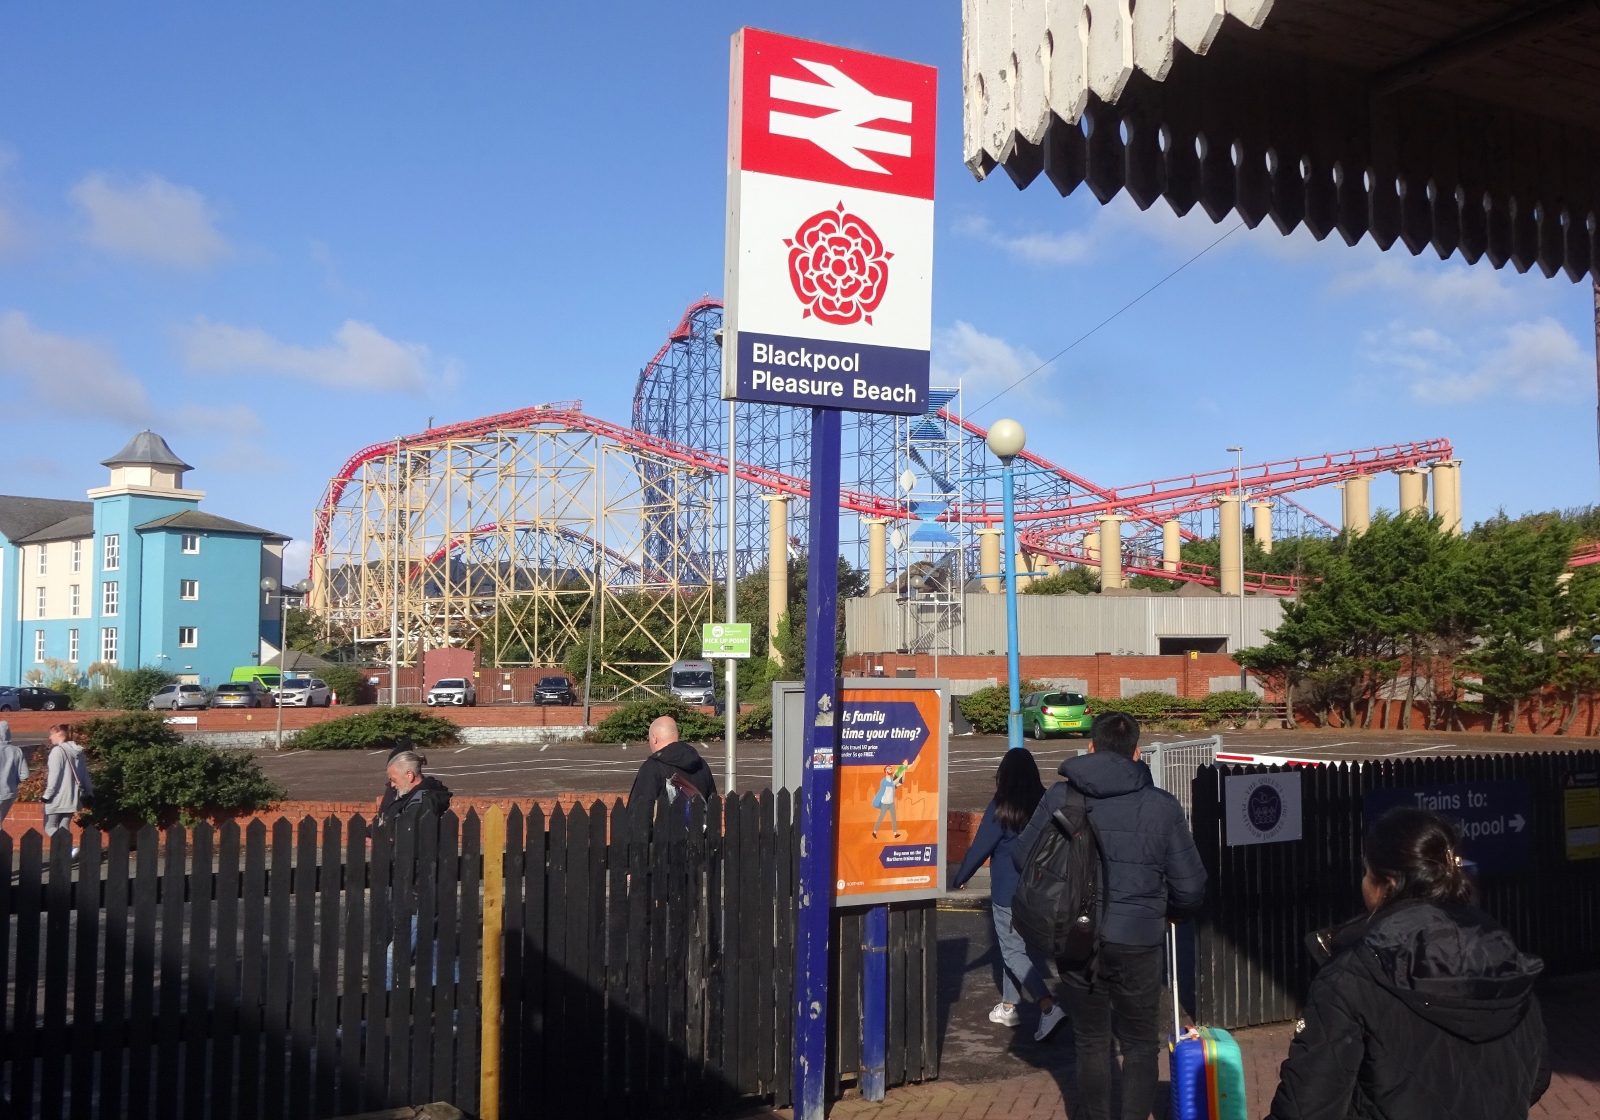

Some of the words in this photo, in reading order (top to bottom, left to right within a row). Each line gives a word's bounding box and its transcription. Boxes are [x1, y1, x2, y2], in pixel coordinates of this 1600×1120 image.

[753, 342, 859, 372] Blackpool
[752, 370, 844, 397] Pleasure
[853, 379, 916, 403] Beach
[842, 711, 851, 722] Is
[851, 711, 885, 725] family
[842, 727, 864, 739] time
[866, 730, 890, 741] your
[891, 727, 921, 741] thing?
[1245, 782, 1257, 795] THE
[1414, 790, 1461, 811] Trains
[1467, 789, 1487, 808] to:
[1241, 803, 1261, 839] PLATINUM
[1454, 815, 1504, 841] kpool
